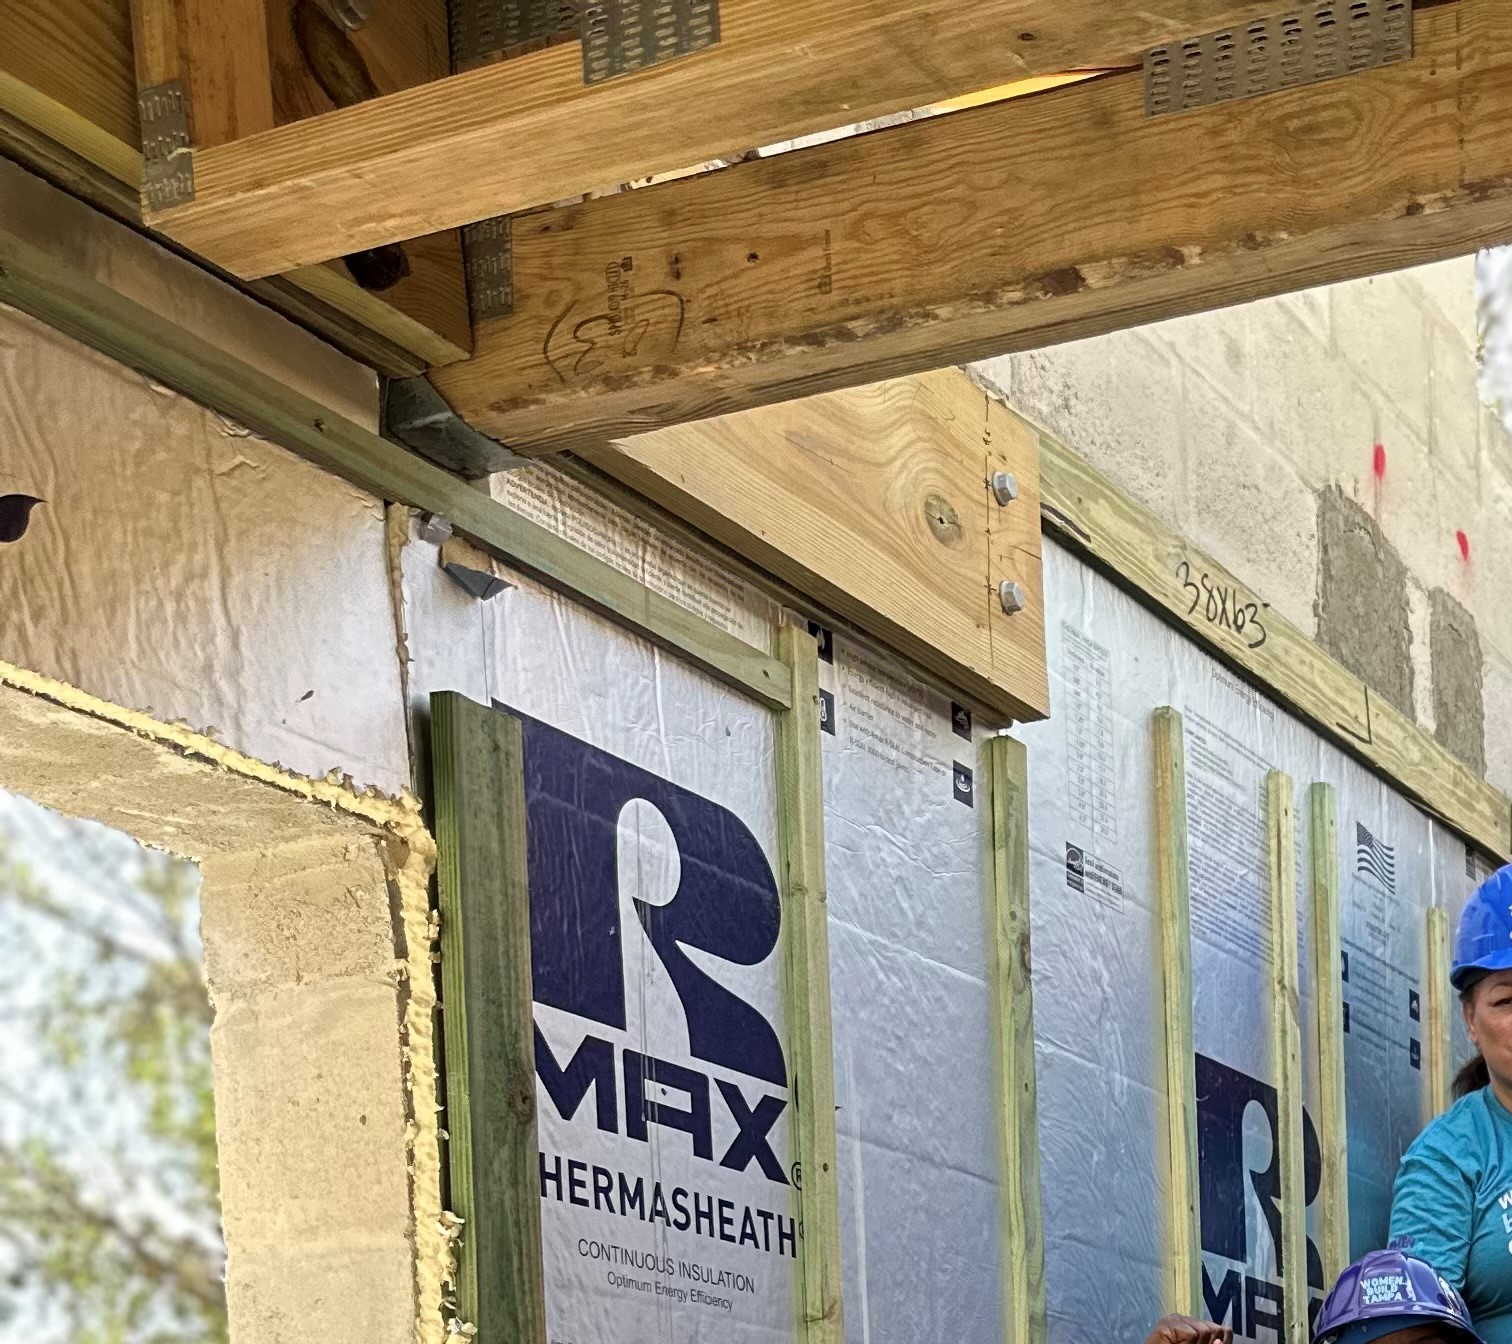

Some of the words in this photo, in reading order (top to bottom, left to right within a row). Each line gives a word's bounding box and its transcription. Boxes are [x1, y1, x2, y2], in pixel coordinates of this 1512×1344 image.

[539, 1151, 797, 1259] HERMASHEATH
[578, 1238, 675, 1276] CONTINUOUS
[678, 1260, 755, 1294] INSULATION
[607, 1271, 653, 1293] Optimum
[655, 1281, 688, 1303] Energy
[690, 1289, 733, 1312] Efficiency
[1360, 1276, 1404, 1289] WOMEN
[1366, 1284, 1399, 1295] BUILD
[1362, 1292, 1403, 1304] TAMPA
